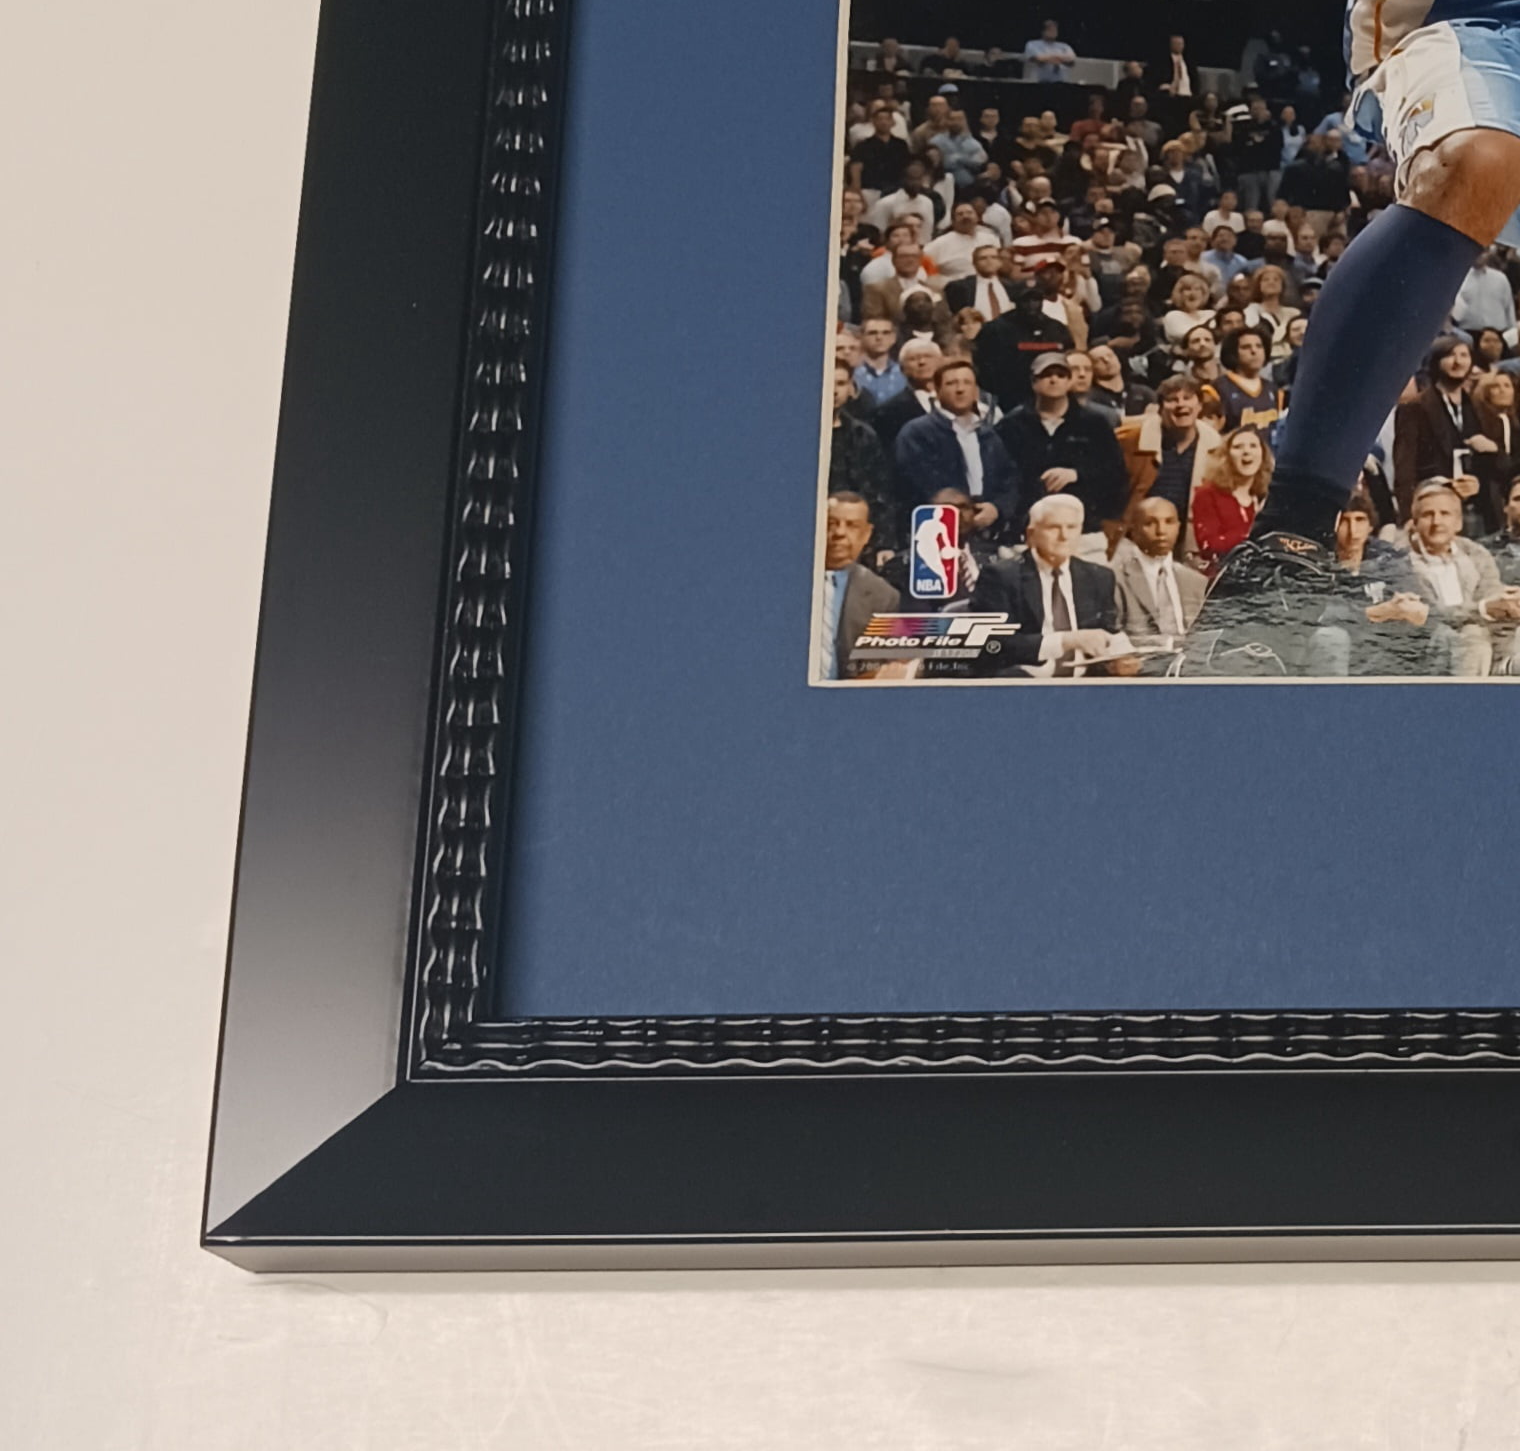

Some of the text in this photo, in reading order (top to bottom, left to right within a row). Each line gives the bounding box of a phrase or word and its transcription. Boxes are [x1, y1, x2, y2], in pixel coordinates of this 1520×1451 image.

[916, 579, 942, 592] NBA
[855, 635, 962, 647] Photo File
